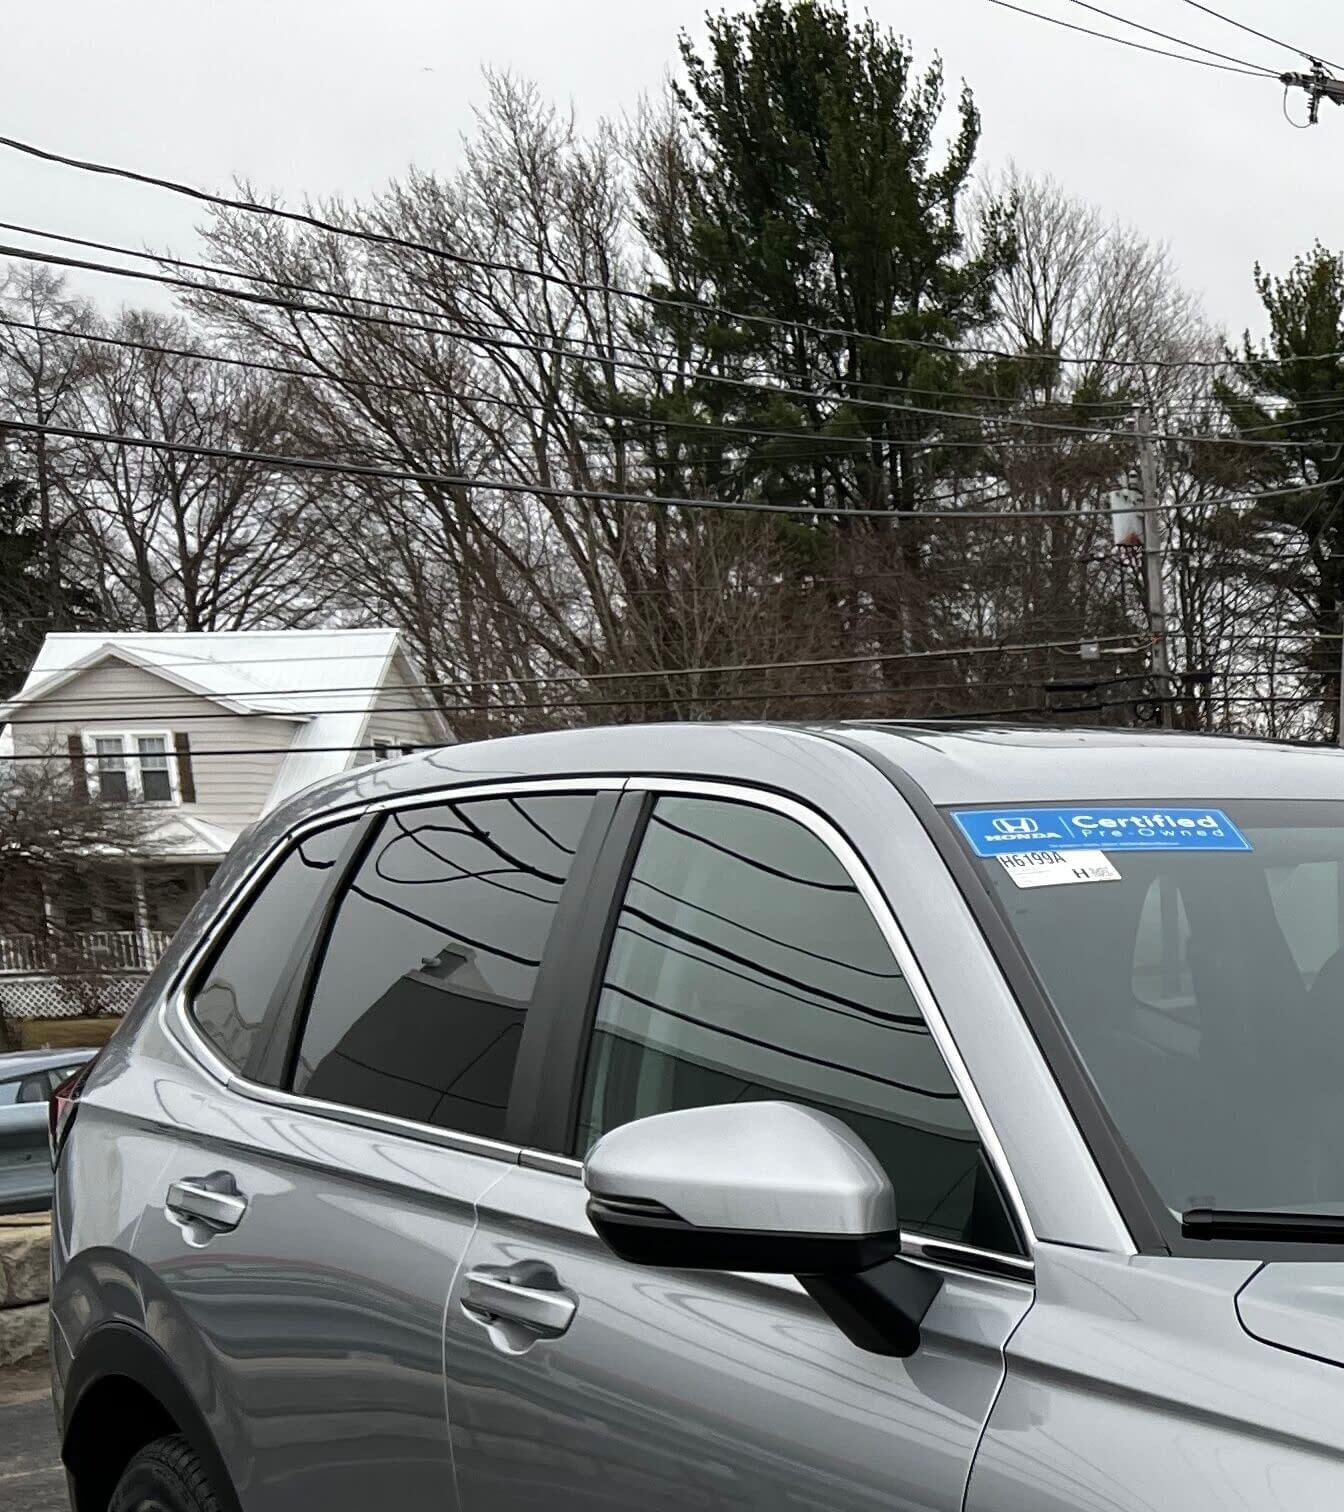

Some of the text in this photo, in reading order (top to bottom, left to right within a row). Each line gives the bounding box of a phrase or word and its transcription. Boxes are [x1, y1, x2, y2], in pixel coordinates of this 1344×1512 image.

[1071, 814, 1219, 829] Certified
[985, 832, 1063, 842] HONDA
[1000, 851, 1067, 869] H6199A
[1072, 868, 1090, 879] H
